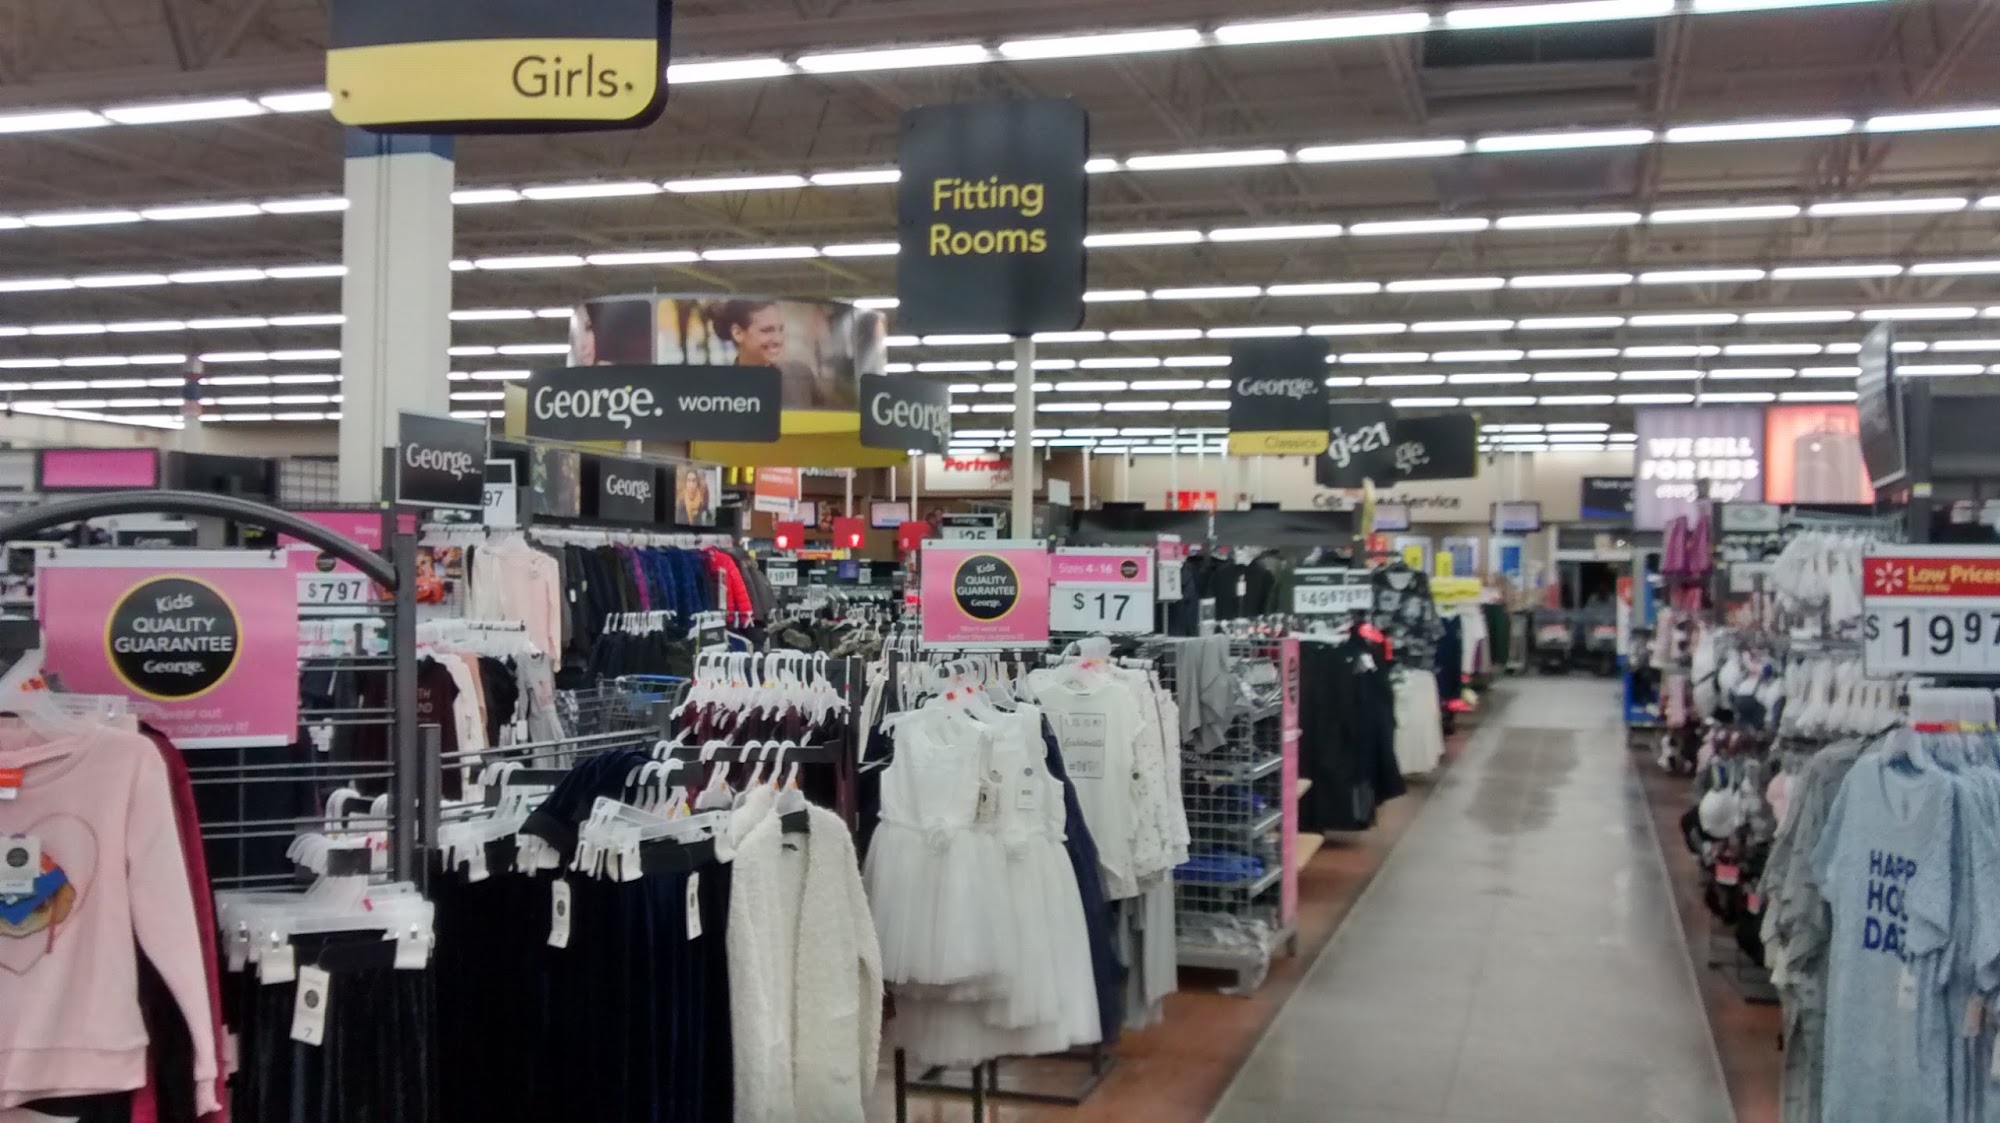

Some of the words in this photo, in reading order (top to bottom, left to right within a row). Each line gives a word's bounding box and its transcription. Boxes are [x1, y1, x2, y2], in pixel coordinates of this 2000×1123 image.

[512, 53, 618, 98] Girls
[932, 175, 1045, 217] Fitting
[929, 222, 1047, 256] Rooms
[1237, 376, 1318, 400] George.
[534, 384, 664, 430] George.
[678, 395, 761, 413] women
[1647, 437, 1693, 458] WE
[1694, 437, 1754, 458] SELL
[406, 442, 475, 480] George.
[1640, 459, 1696, 480] FOR
[1697, 459, 1760, 480] LESS
[976, 563, 996, 574] Kids
[1907, 565, 1948, 583] Low
[956, 585, 1016, 596] GUARANTEE
[965, 575, 1007, 585] QUALITY
[156, 593, 194, 613] Kids
[132, 616, 216, 634] QUALITY
[114, 635, 233, 653] GUARANTEE
[143, 659, 206, 676] George.
[1869, 849, 1918, 882] HAPP
